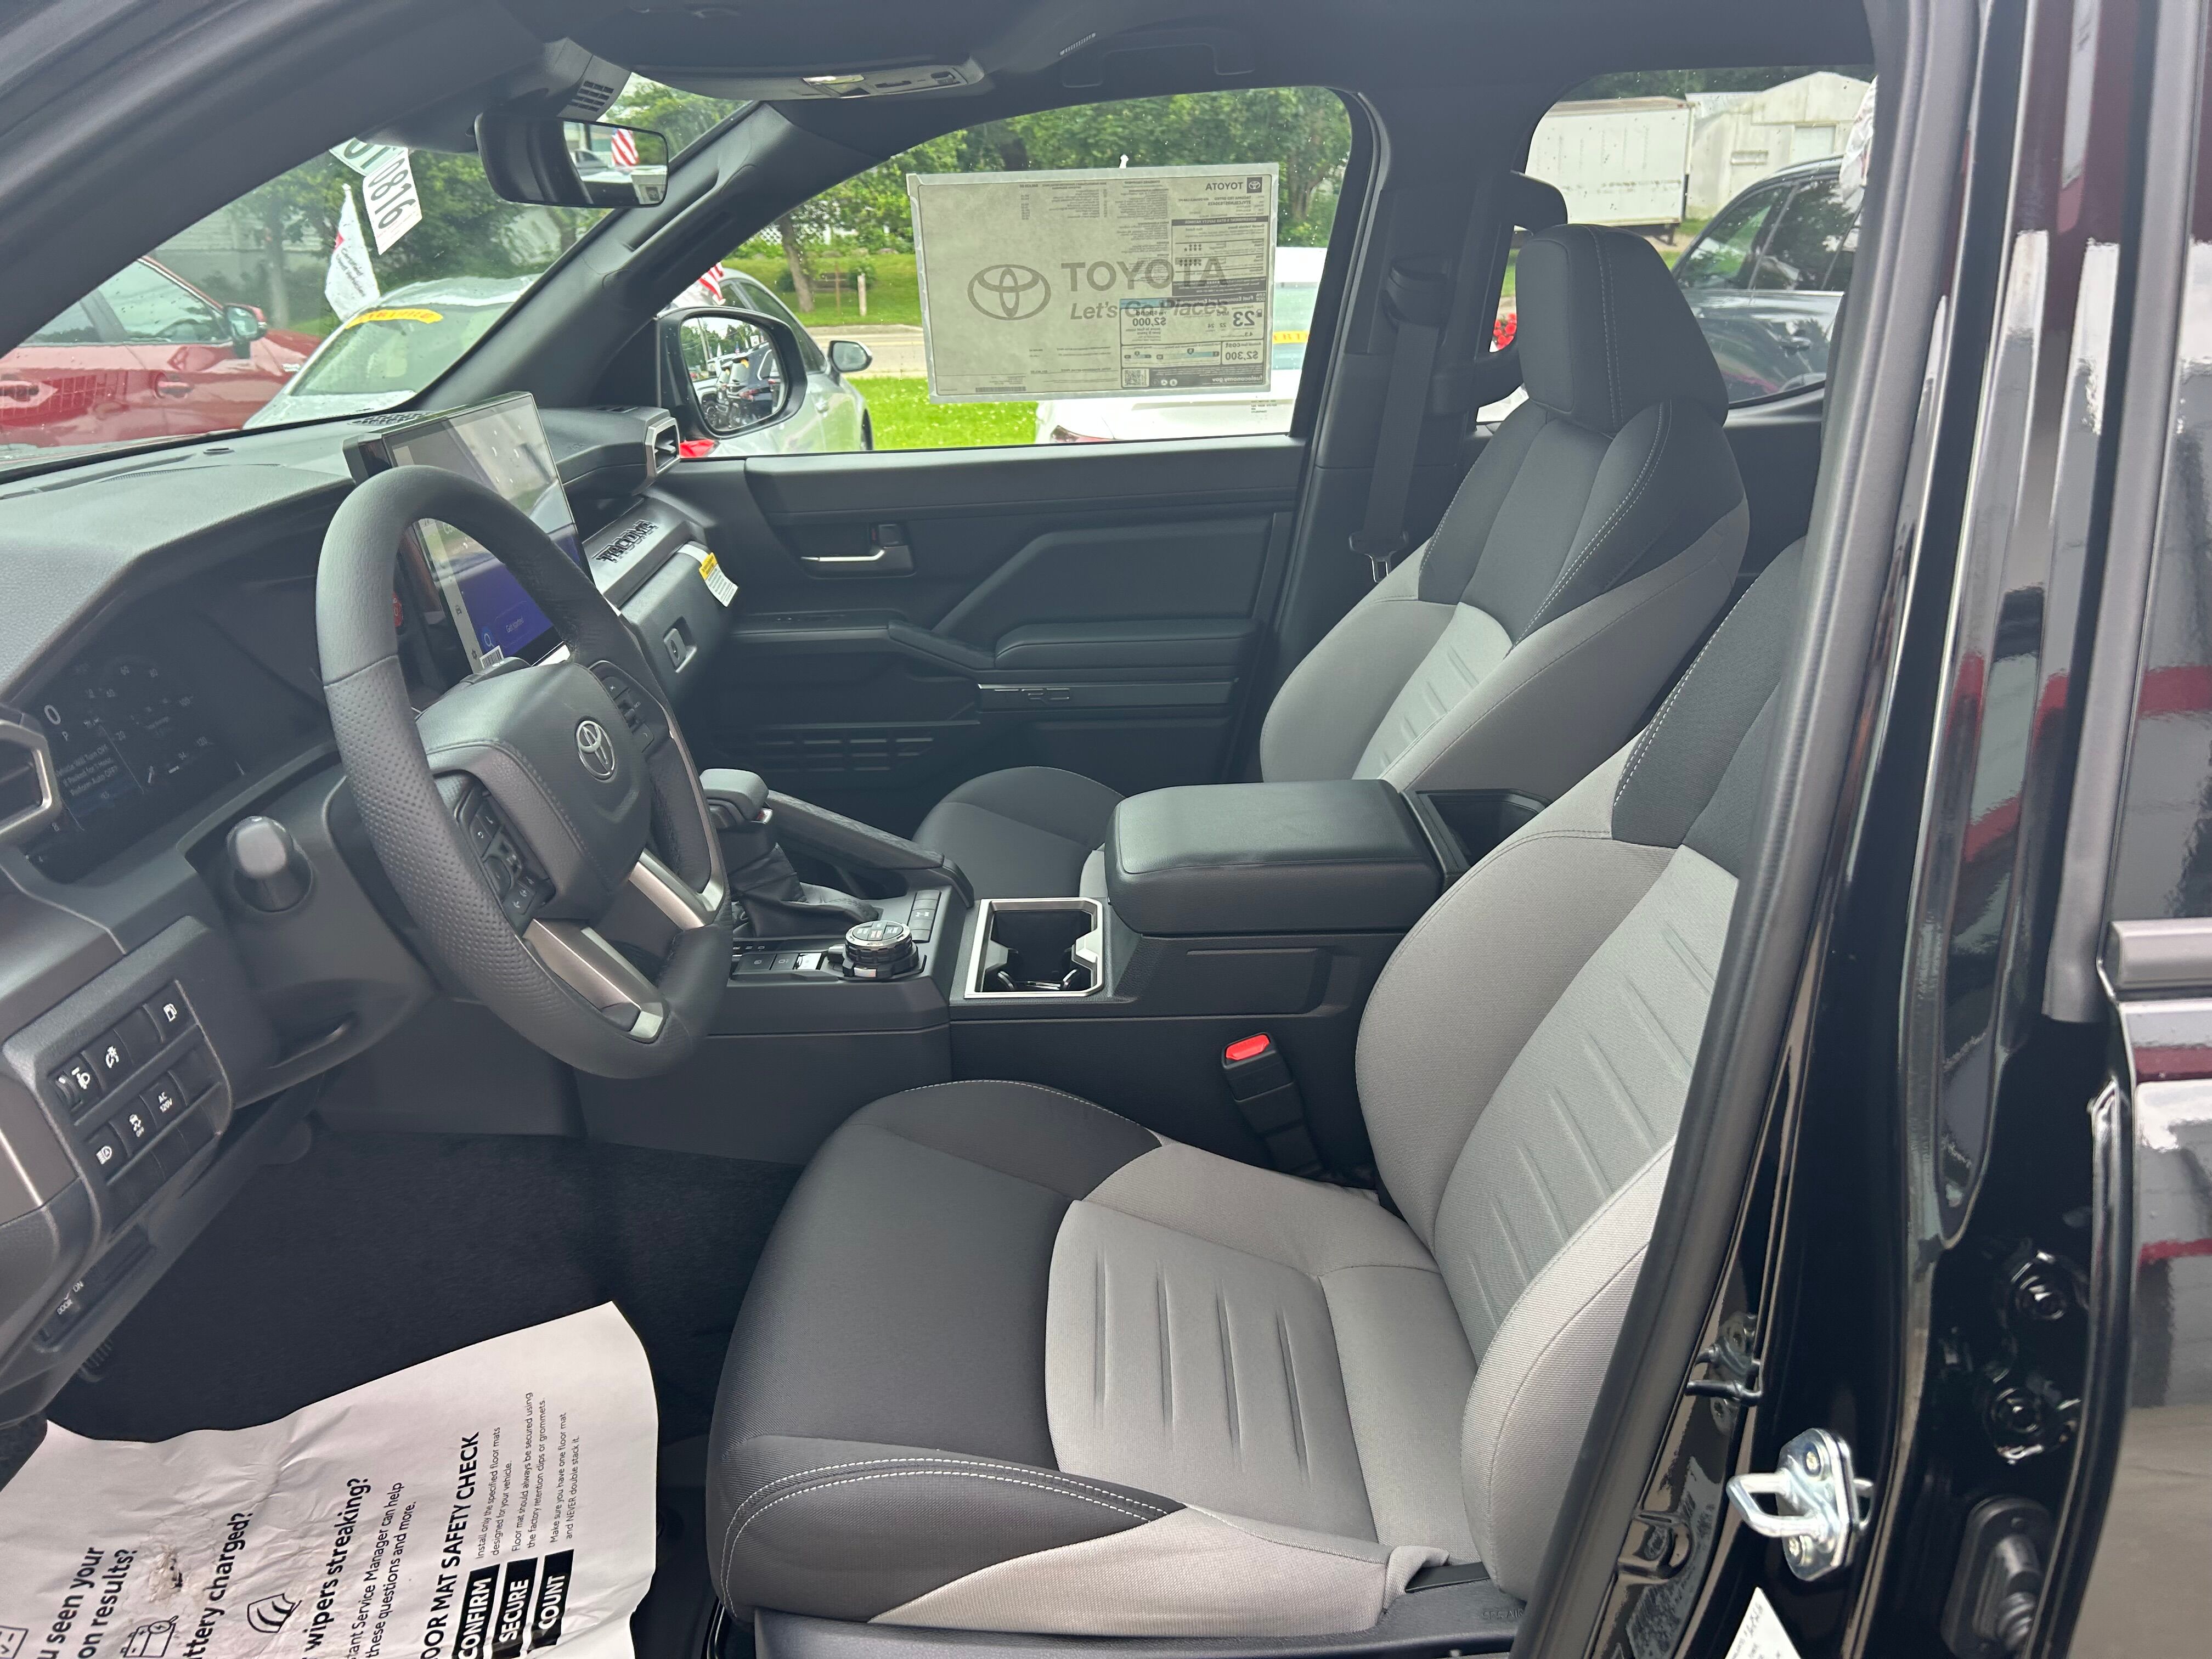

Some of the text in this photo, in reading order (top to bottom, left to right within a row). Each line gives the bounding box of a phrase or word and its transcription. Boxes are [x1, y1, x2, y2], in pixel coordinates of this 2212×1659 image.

[368, 157, 416, 229] 0816
[1061, 257, 1228, 291] TOYOTA
[592, 519, 659, 563] TACOMA
[994, 688, 1070, 704] TRD
[44, 704, 61, 725] 0
[62, 731, 69, 742] P
[158, 1091, 167, 1104] AC
[57, 1299, 73, 1314] DOOR
[524, 1392, 533, 1417] using
[524, 1418, 533, 1449] secured
[558, 1431, 567, 1450] floor
[490, 1445, 499, 1469] floor
[522, 1451, 532, 1463] be
[571, 1444, 580, 1465] stack
[521, 1463, 532, 1488] always
[527, 1397, 548, 1548] the factory retention clips or grommets.
[556, 1468, 565, 1488] have
[569, 1466, 578, 1494] double
[383, 1482, 404, 1509] help
[488, 1470, 498, 1504] specified
[556, 1489, 565, 1504] you
[484, 1505, 493, 1516] the
[491, 1460, 512, 1556] designed for your vehicle.
[517, 1490, 528, 1514] should
[554, 1504, 562, 1519] sure
[566, 1496, 577, 1522] NEVER
[381, 1508, 395, 1527] can
[481, 1517, 492, 1532] only
[511, 1531, 522, 1551] Floor
[550, 1521, 560, 1543] Make
[565, 1523, 573, 1539] and
[363, 1529, 390, 1582] Manager
[420, 1431, 479, 1659] OOR MAT SAFETY CHECK
[476, 1533, 487, 1559] Install
[302, 1478, 371, 1652] wipers streaking?
[91, 1549, 138, 1629] results?
[183, 1513, 254, 1659] ttery charged?
[365, 1501, 417, 1658] these questions and more.
[47, 1594, 84, 1644] seen
[70, 1547, 105, 1589] your
[352, 1584, 377, 1629] Service
[538, 1575, 566, 1629] COUNT
[458, 1577, 493, 1659] CONFIRM
[499, 1578, 529, 1642] SECURE
[1506, 1608, 1524, 1619] AIR
